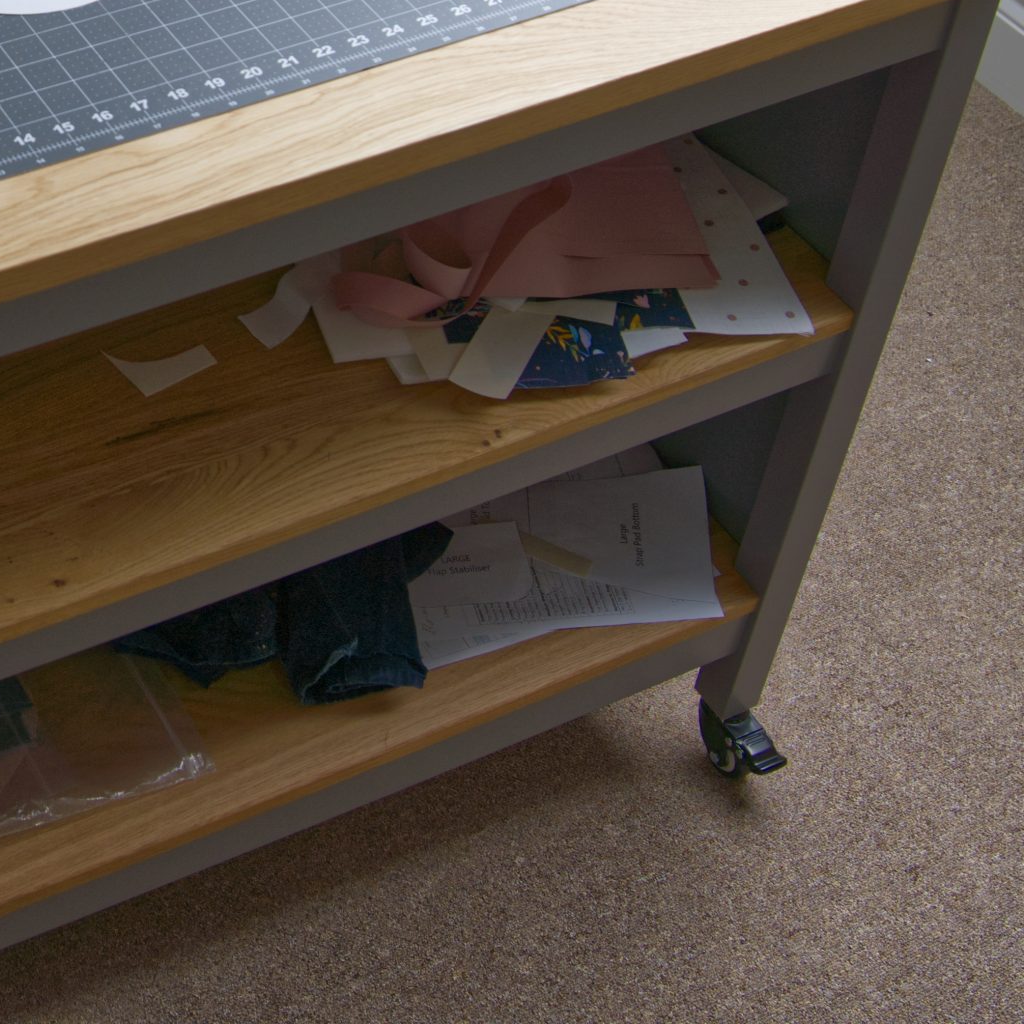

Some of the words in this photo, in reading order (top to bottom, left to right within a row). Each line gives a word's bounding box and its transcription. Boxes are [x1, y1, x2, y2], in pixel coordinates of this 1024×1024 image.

[14, 133, 35, 145] 14
[53, 122, 74, 134] 15
[92, 110, 113, 122] 16
[130, 99, 148, 111] 17
[168, 88, 189, 100] 18
[205, 78, 225, 89] 19
[240, 66, 263, 79] 20
[278, 56, 299, 68] 21
[312, 45, 335, 58] 22
[348, 35, 369, 47] 23
[382, 24, 404, 36] 24
[417, 14, 438, 26] 25
[451, 4, 471, 16] 26
[632, 503, 640, 530] Bottom
[620, 524, 628, 544] Large
[633, 532, 642, 546] Pad
[442, 554, 471, 563] LARGE
[635, 548, 644, 566] Strap
[449, 564, 490, 575] Stabiliser
